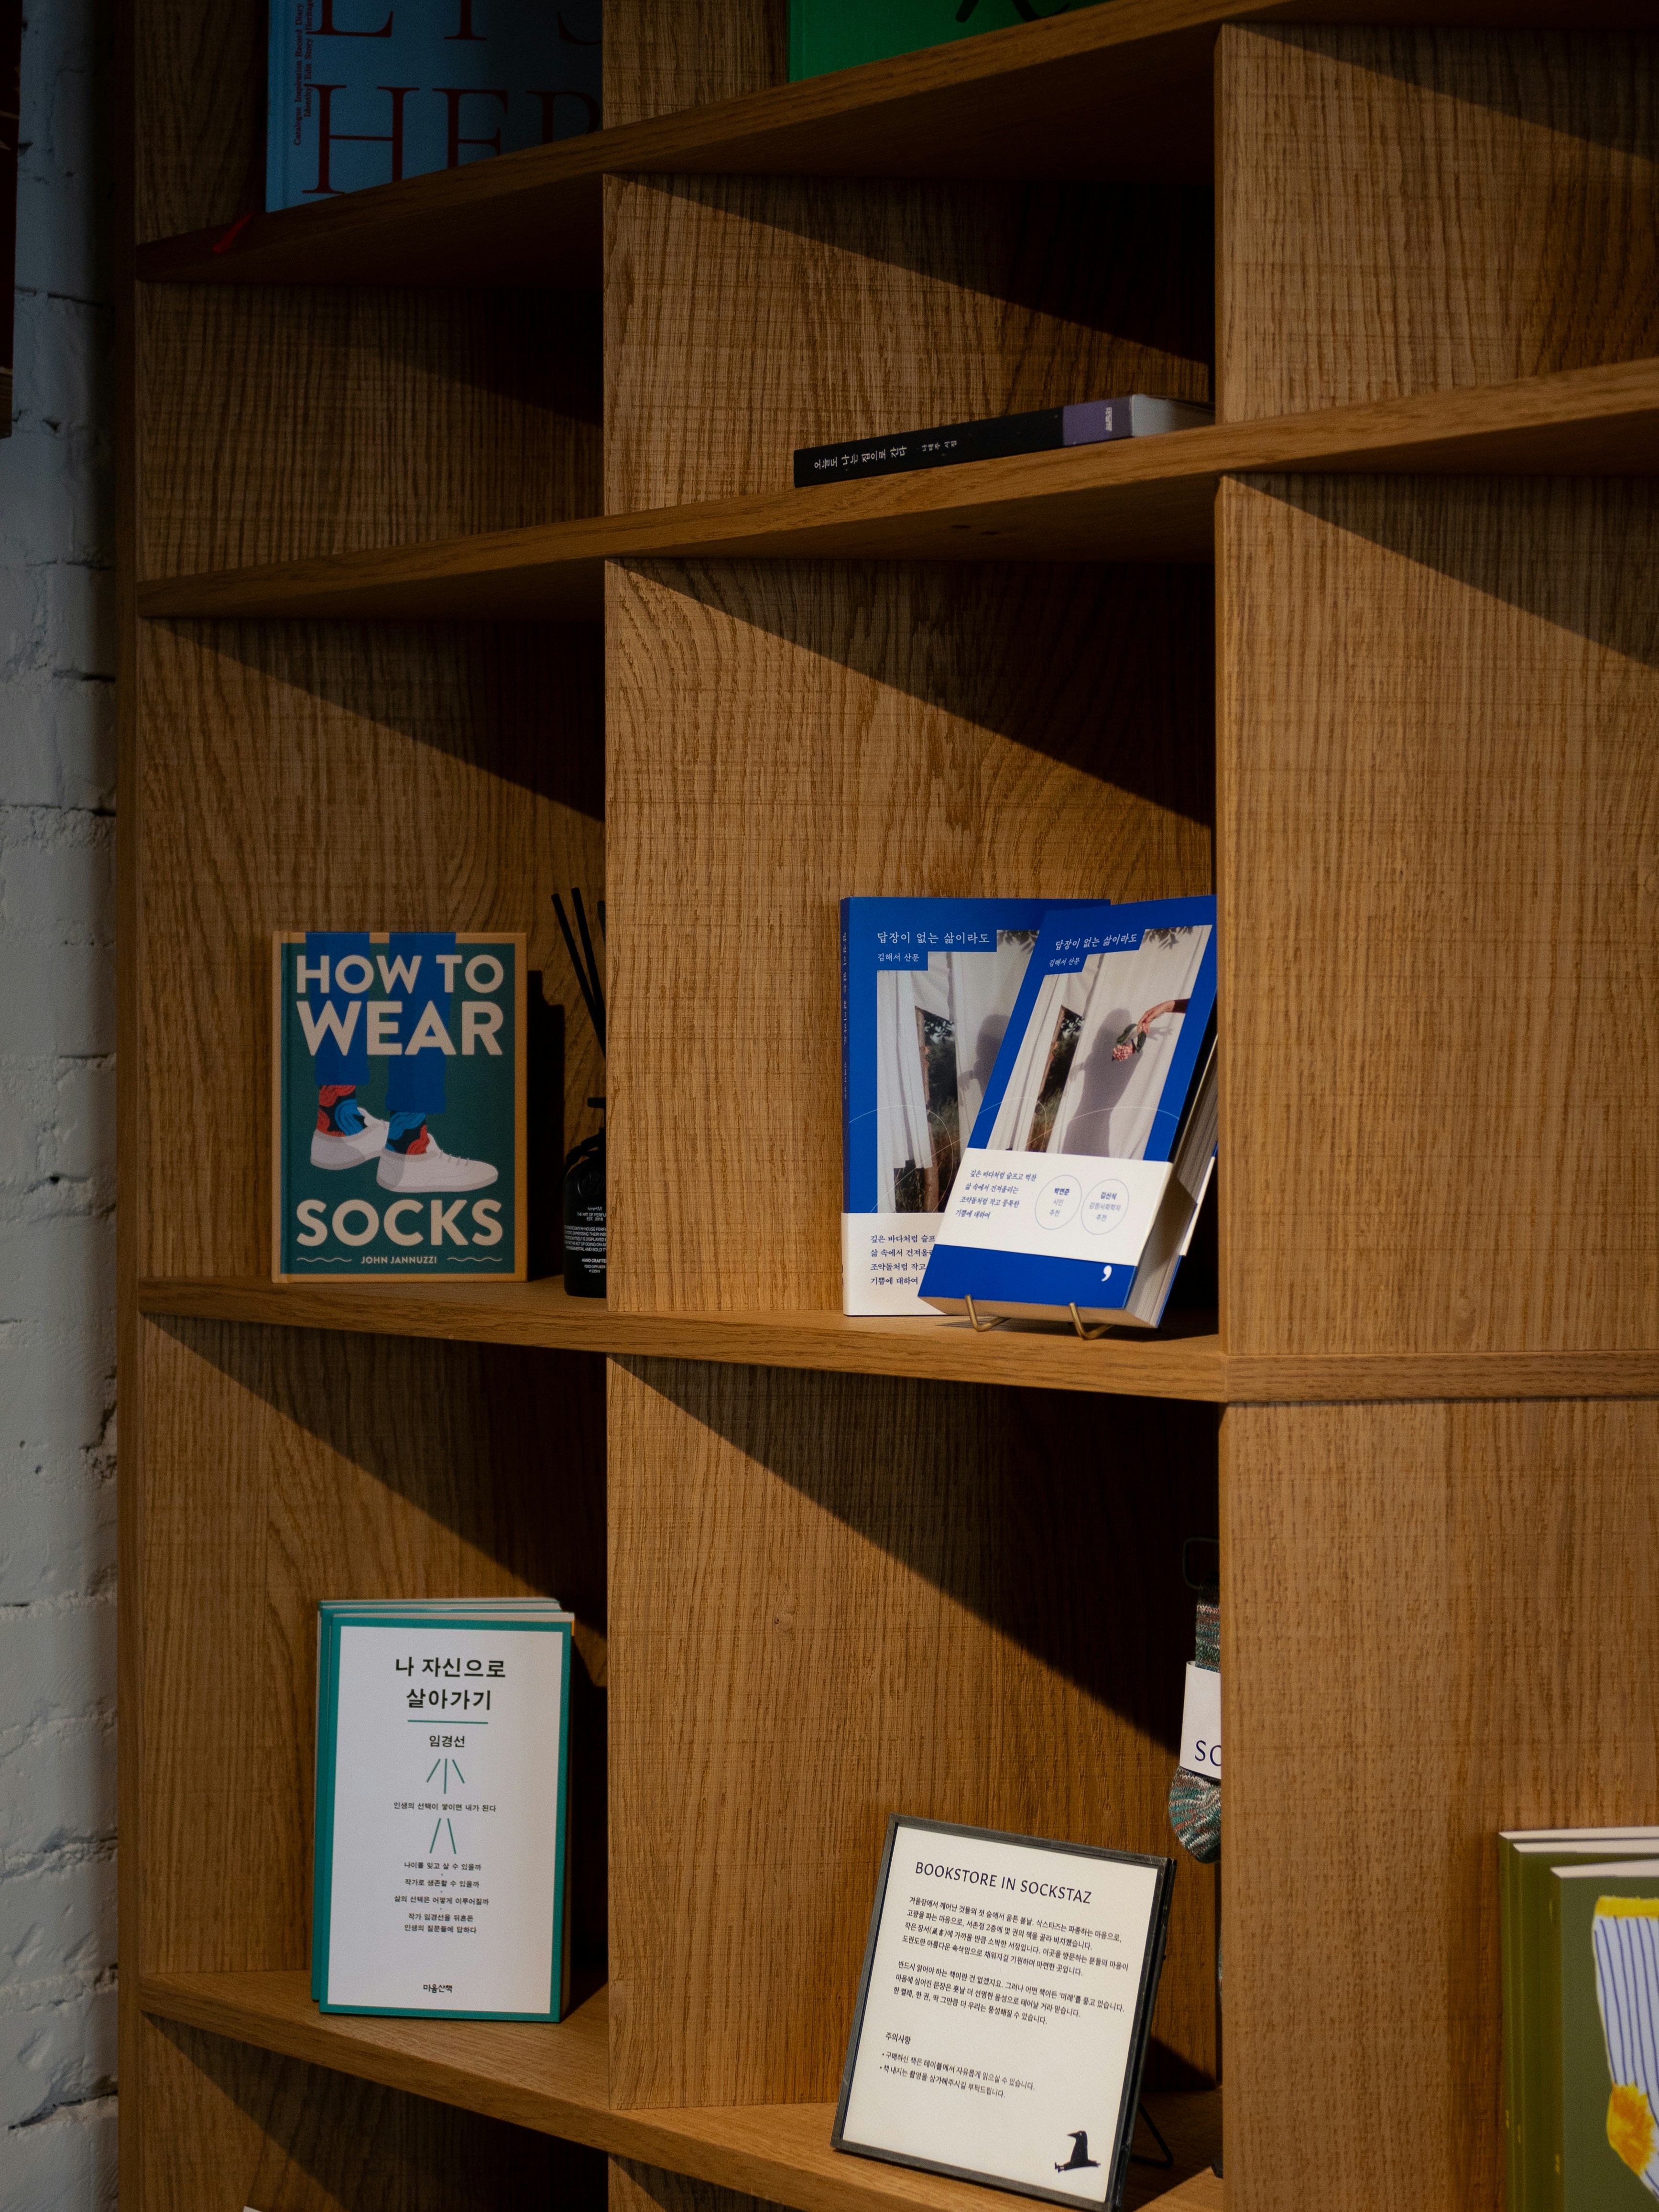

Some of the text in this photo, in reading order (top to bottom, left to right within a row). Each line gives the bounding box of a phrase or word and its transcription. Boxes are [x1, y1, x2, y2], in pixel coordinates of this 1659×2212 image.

[295, 61, 303, 102] Inspiration
[294, 108, 302, 145] Catalogue
[814, 446, 907, 469] 오늘도 나는 집으로 간다
[877, 931, 989, 944] 답장이 없는 삶이라도
[1055, 933, 1137, 950] 답장이 없는 삶이라도
[877, 952, 919, 961] 김해서 산문
[1049, 957, 1080, 967] 김해서 산문
[296, 955, 504, 994] HOW TO
[296, 1001, 503, 1056] WEAR
[296, 1199, 503, 1246] SOCKS
[870, 1234, 917, 1243] 깊은 바다처럼
[361, 1256, 437, 1264] JOHN JANNUZZI
[870, 1248, 902, 1257] 삶 속에서
[870, 1262, 907, 1271] 조약돌처럼
[870, 1276, 917, 1285] 기쁨에 대하여
[396, 1656, 505, 1678] 나 자신으로
[406, 1689, 491, 1711] 살아가기
[429, 1735, 465, 1747] 임경선
[915, 1861, 1091, 1904] BOOKSTORE IN SOCKSTAZ
[906, 1909, 924, 1919] 고랑을
[925, 1912, 937, 1921] 파는
[939, 1915, 964, 1927] 마음으로,
[966, 1920, 984, 1930] 서촌점
[985, 1923, 1003, 1934] 2층에
[1012, 1928, 1024, 1938] 권의
[1026, 1931, 1038, 1940] 책을
[909, 1896, 939, 1908] 겨울잠에서
[939, 1902, 957, 1912] 깨어난
[959, 1905, 977, 1916] 것들의
[978, 1909, 984, 1917] 첫
[1006, 1914, 1018, 1923] 움튼
[1020, 1916, 1034, 1926] 봄날.
[1036, 1919, 1067, 1932] 삭스타즈는
[1068, 1925, 1093, 1937] 파종하는
[1094, 1930, 1121, 1943] 마음으로,
[902, 1935, 1082, 1976] 도란도란 아름다운 속삭임으로 채워지길 기원하며 마련한 곳입니다.
[905, 1922, 1128, 1972] 작은 가까울 만큼 소박한 서점입니다. 이곳을 방문하는 분들의 마음이
[423, 1984, 452, 1994] 마음산책
[895, 1973, 1080, 2017] 마음에 심어진 문장은 더 선명한 음성으로 태어날 거라 믿습니다.
[898, 1961, 915, 1971] 반드시
[917, 1964, 934, 1974] 읽어야
[935, 1968, 948, 1977] 하는
[949, 1970, 967, 1981] 책이란
[969, 1974, 975, 1983] 건
[977, 1976, 1003, 1988] 없겠지요.
[1005, 1982, 1024, 1992] 그러나
[1025, 1985, 1037, 1995] 어떤
[1039, 1988, 1057, 1999] 책이든
[1097, 1999, 1122, 2012] 있습니다.
[894, 1986, 899, 1994] 한
[916, 1991, 922, 1999] 한
[923, 1992, 930, 2002] 권,
[933, 1994, 939, 2003] 딱
[939, 1996, 959, 2006] 그만큼
[960, 2000, 966, 2008] 더
[967, 2001, 986, 2012] 우리는
[988, 2005, 1012, 2018] 풍성해질
[1014, 2011, 1020, 2019] 수
[1021, 2012, 1047, 2025] 있습니다.
[885, 2032, 911, 2045] 주의사항
[883, 2064, 1005, 2098] 책 내지는 삼가해주시길 부탁드립니다.
[885, 2051, 1034, 2091] 구매하신 책은 테이블에서 자유롭게 읽으실 수 있습니다.
